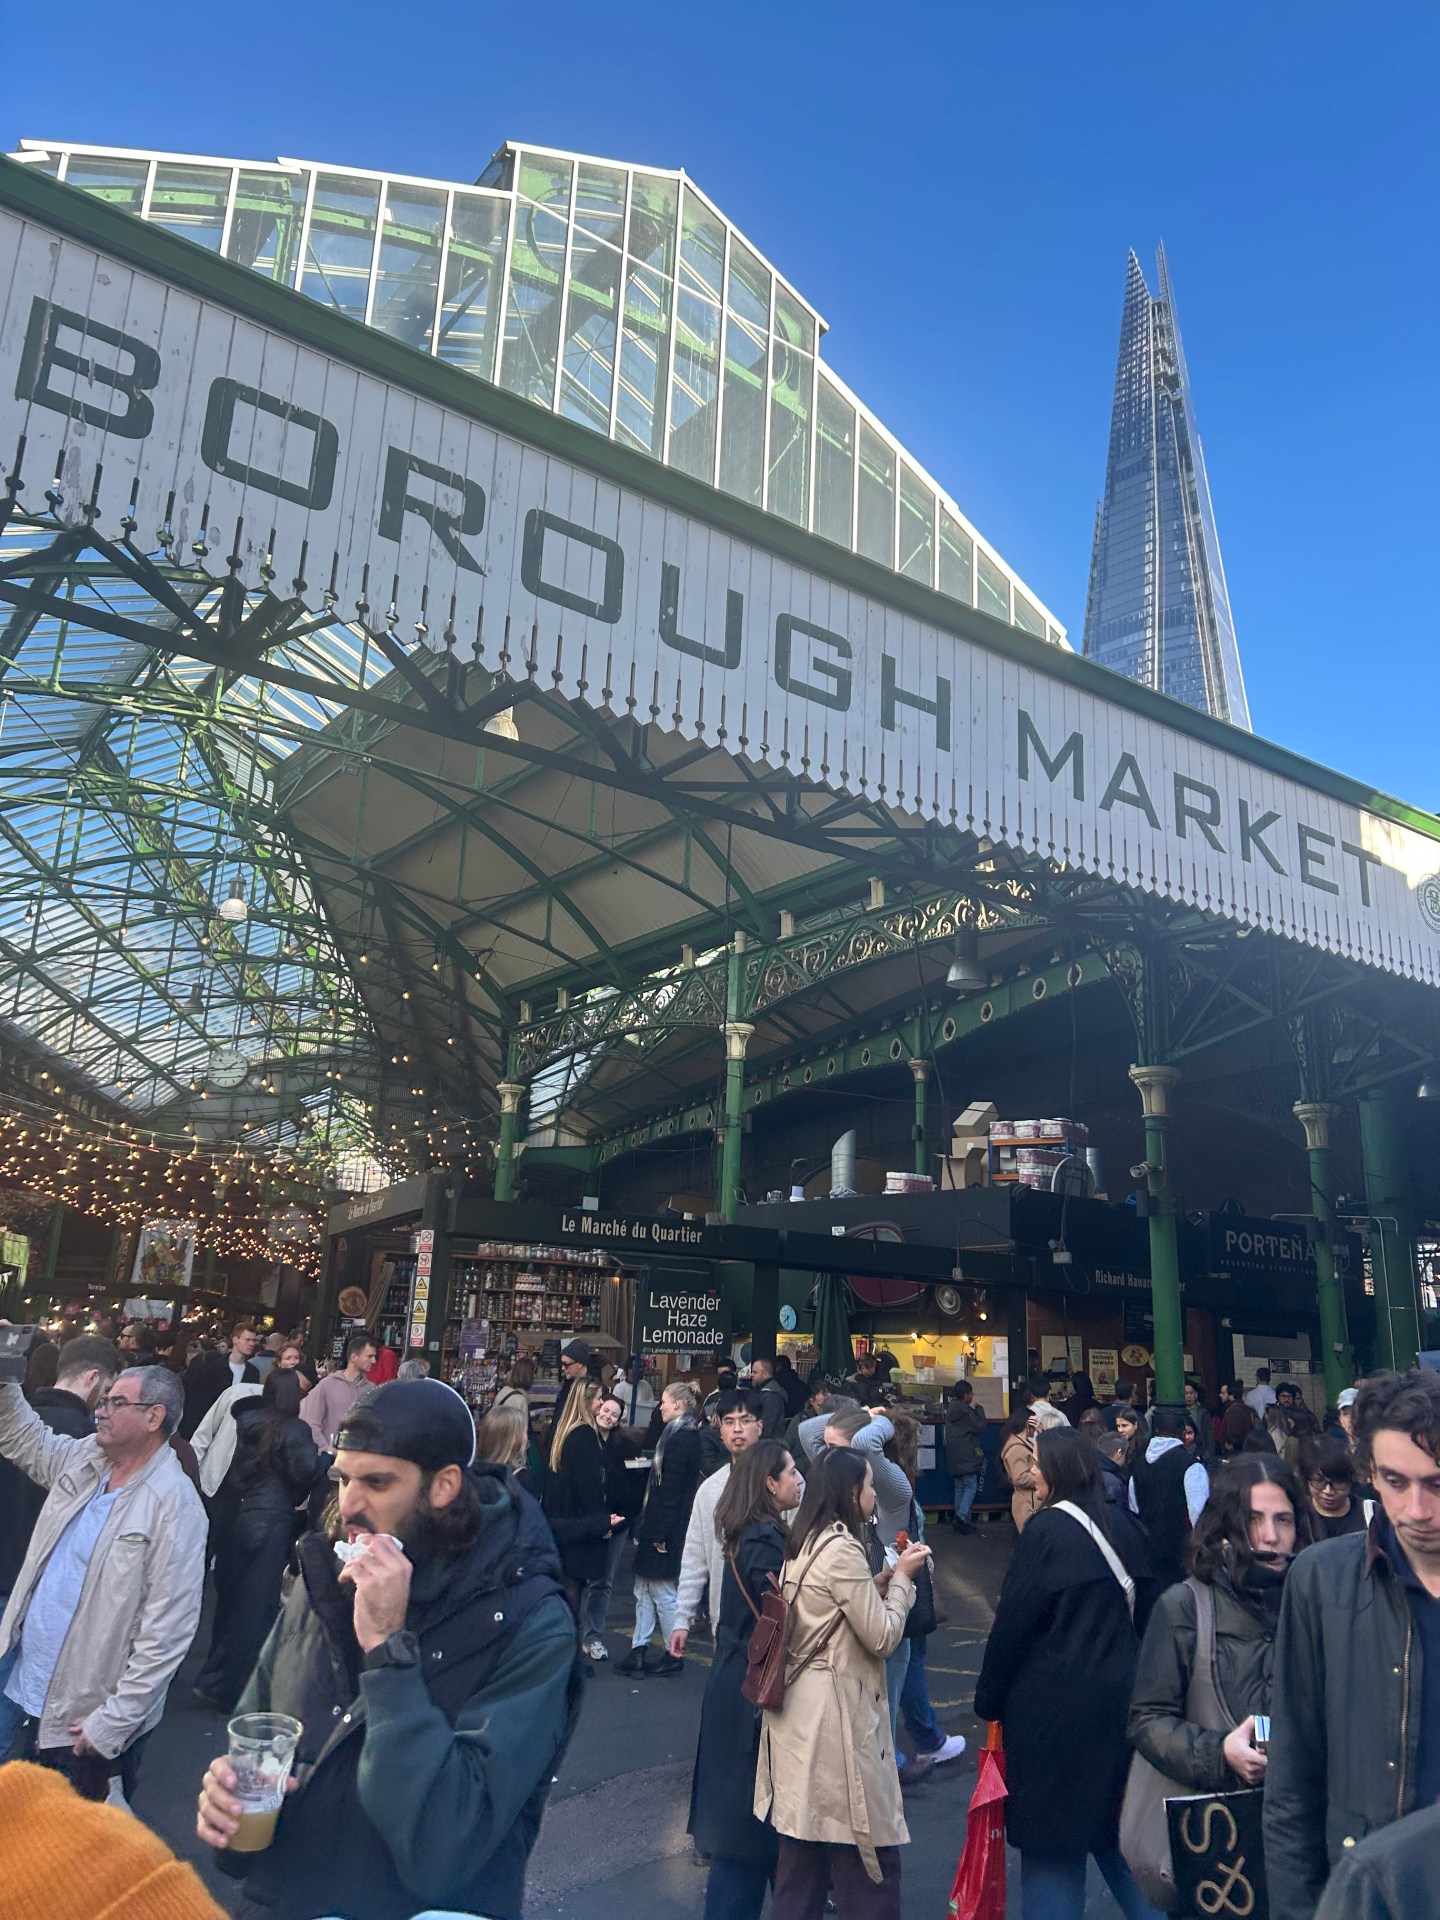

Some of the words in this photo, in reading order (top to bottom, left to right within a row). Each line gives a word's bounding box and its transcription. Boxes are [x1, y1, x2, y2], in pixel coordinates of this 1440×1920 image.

[15, 295, 951, 752] BOROUGH
[1016, 709, 1382, 908] MARKET
[562, 1214, 576, 1232] Le
[581, 1216, 627, 1237] Marché
[631, 1222, 647, 1239] du
[651, 1223, 702, 1243] Quartier
[1225, 1229, 1318, 1262] PORTEÑA
[1095, 1269, 1125, 1286] Richard
[1268, 1264, 1297, 1273] STREET
[649, 1291, 722, 1311] Lavender
[667, 1309, 707, 1327] Haze
[642, 1326, 724, 1345] Lemonade
